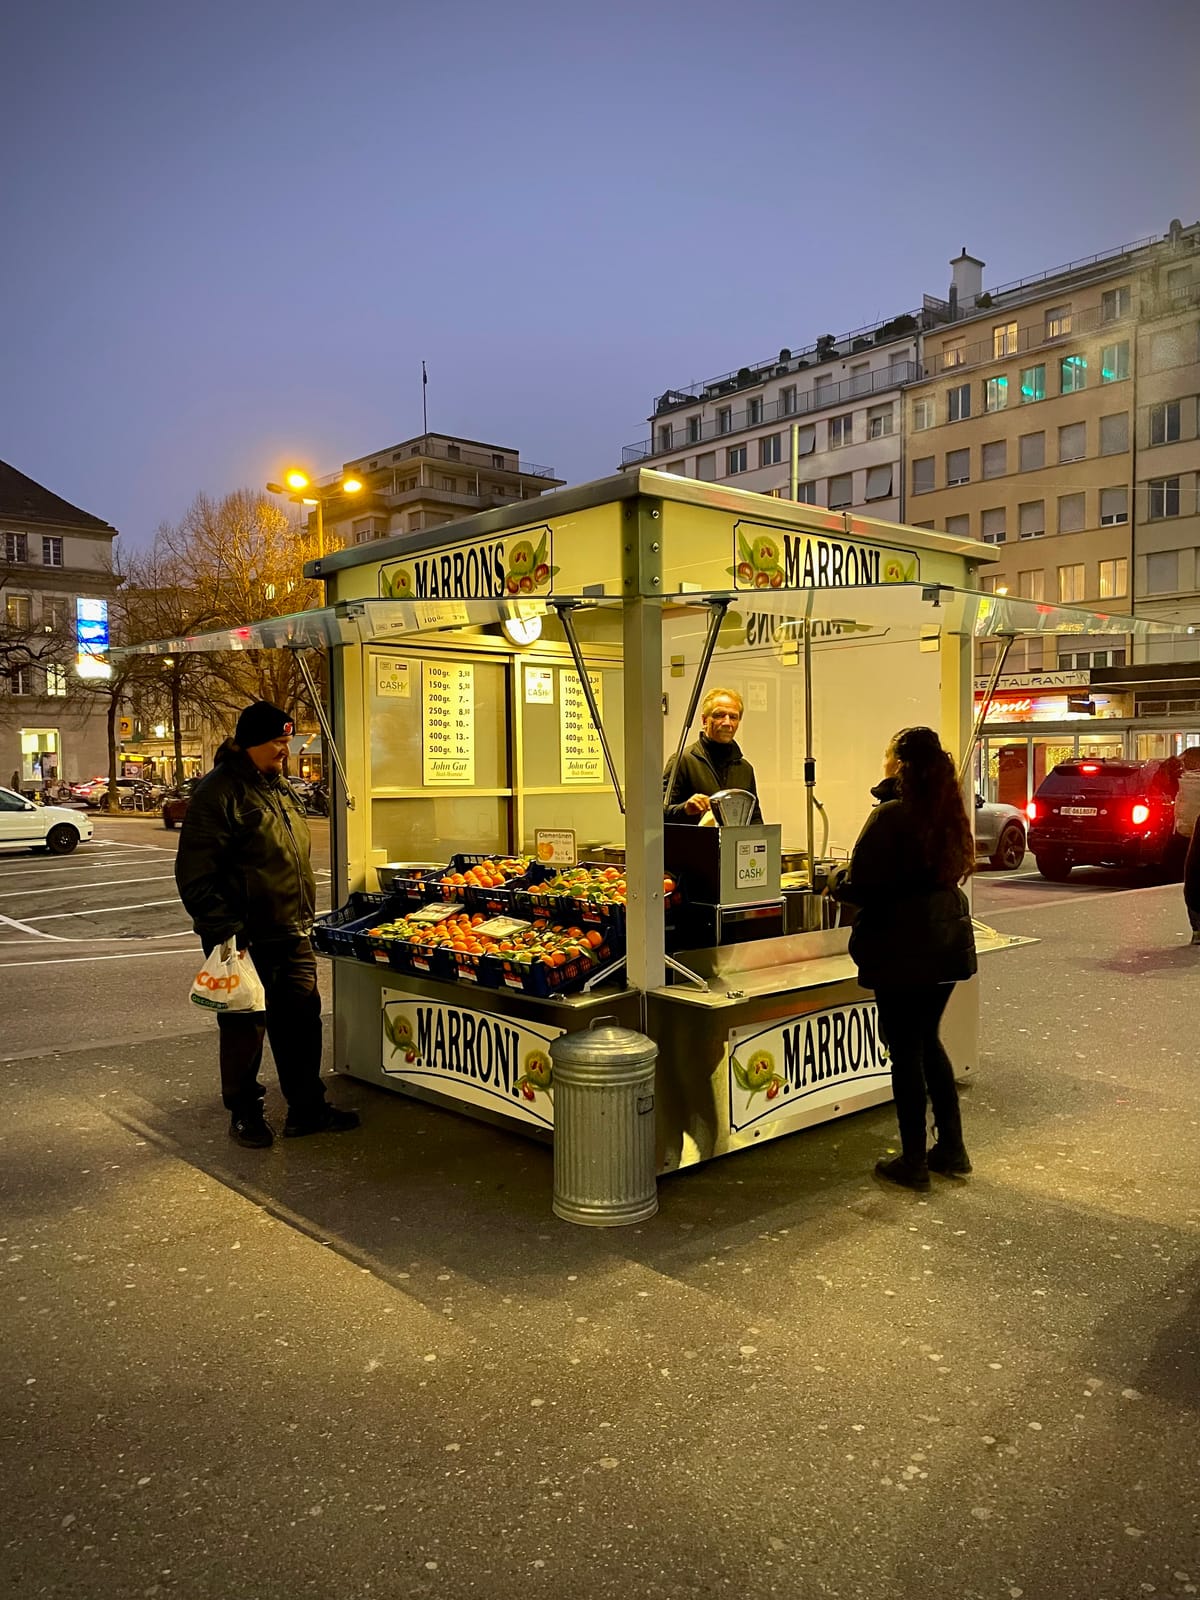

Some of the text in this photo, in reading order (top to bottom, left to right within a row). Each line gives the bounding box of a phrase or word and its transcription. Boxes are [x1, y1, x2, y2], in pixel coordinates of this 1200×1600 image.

[784, 535, 880, 588] MARRONI
[414, 542, 505, 598] MARRONS
[380, 680, 403, 690] CASH
[431, 761, 467, 771] John Gut
[568, 762, 584, 770] John
[739, 868, 761, 879] CASH
[417, 1008, 520, 1097] MARRONI
